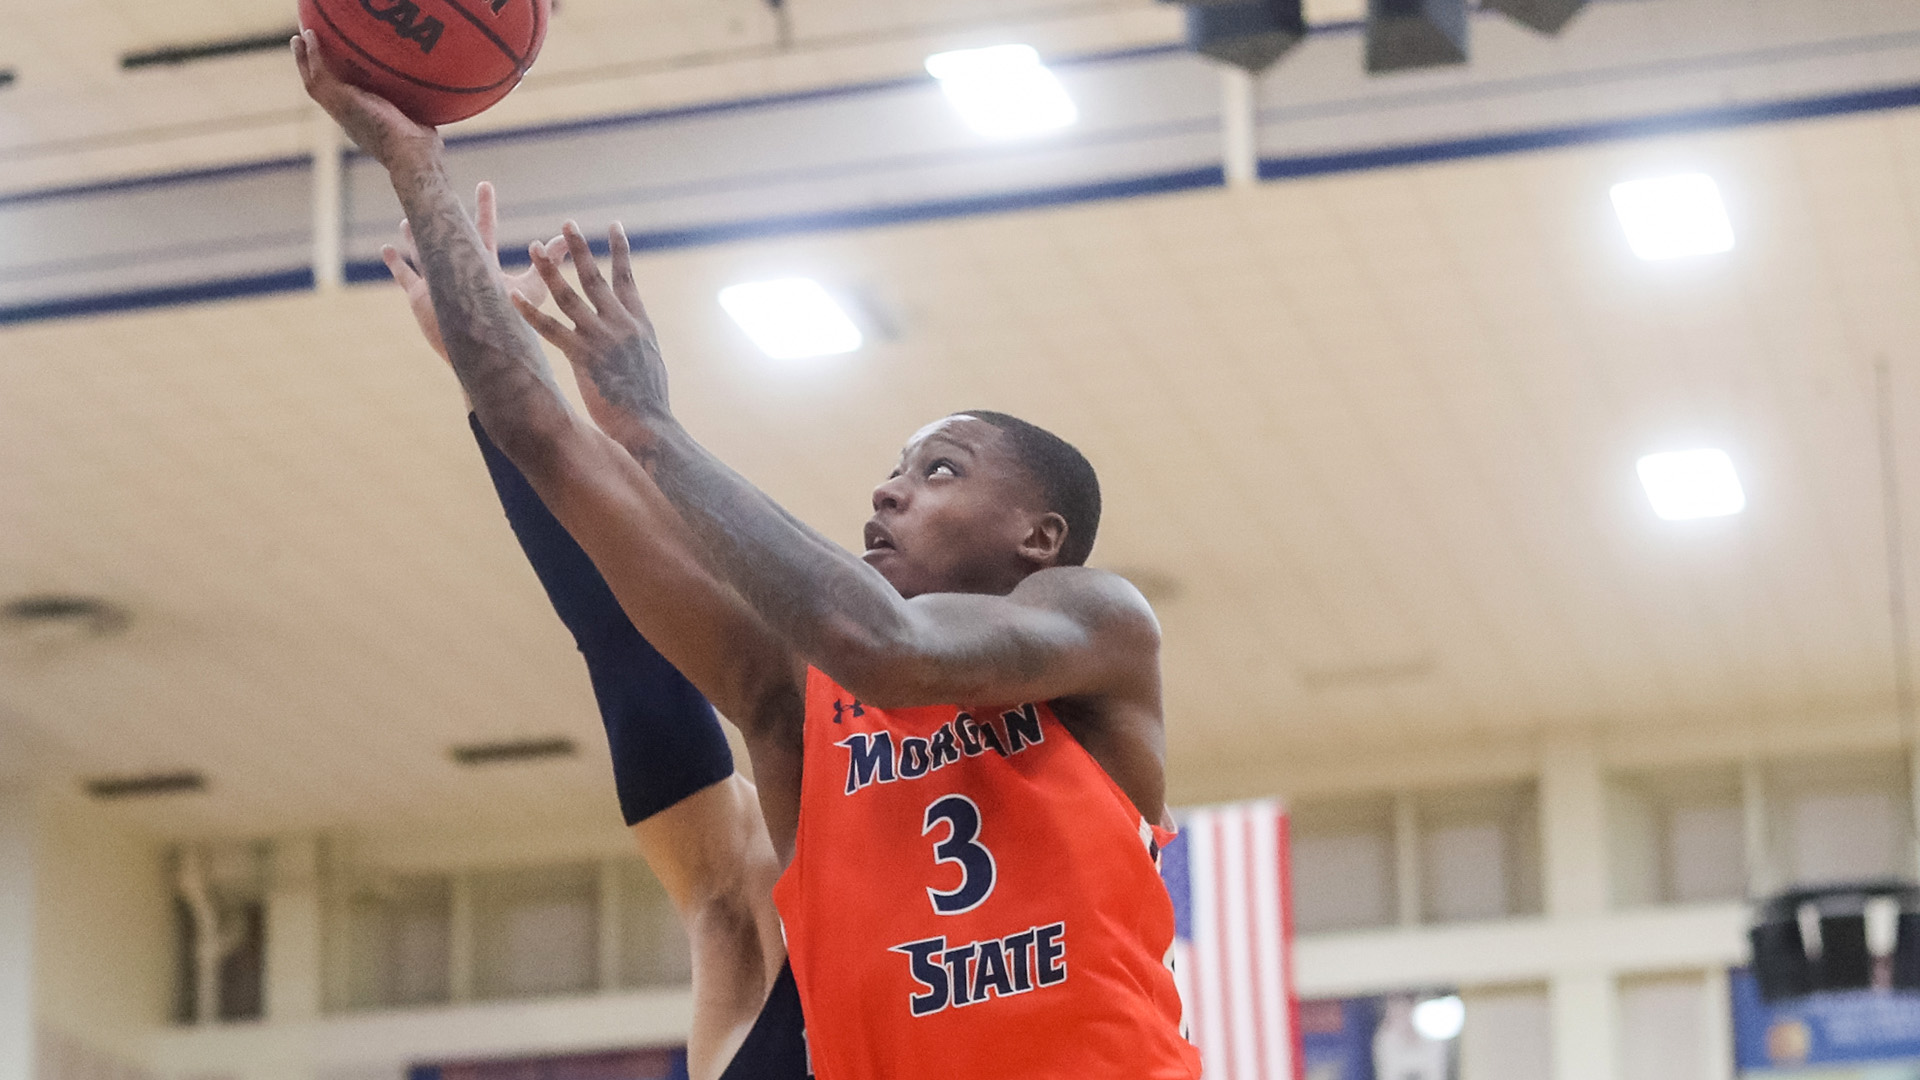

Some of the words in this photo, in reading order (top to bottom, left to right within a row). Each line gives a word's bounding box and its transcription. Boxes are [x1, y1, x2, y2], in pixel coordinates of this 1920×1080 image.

[359, 0, 445, 54] CAA
[833, 702, 1044, 796] MORGAN
[921, 793, 997, 916] 3
[887, 921, 1067, 1018] STATE
